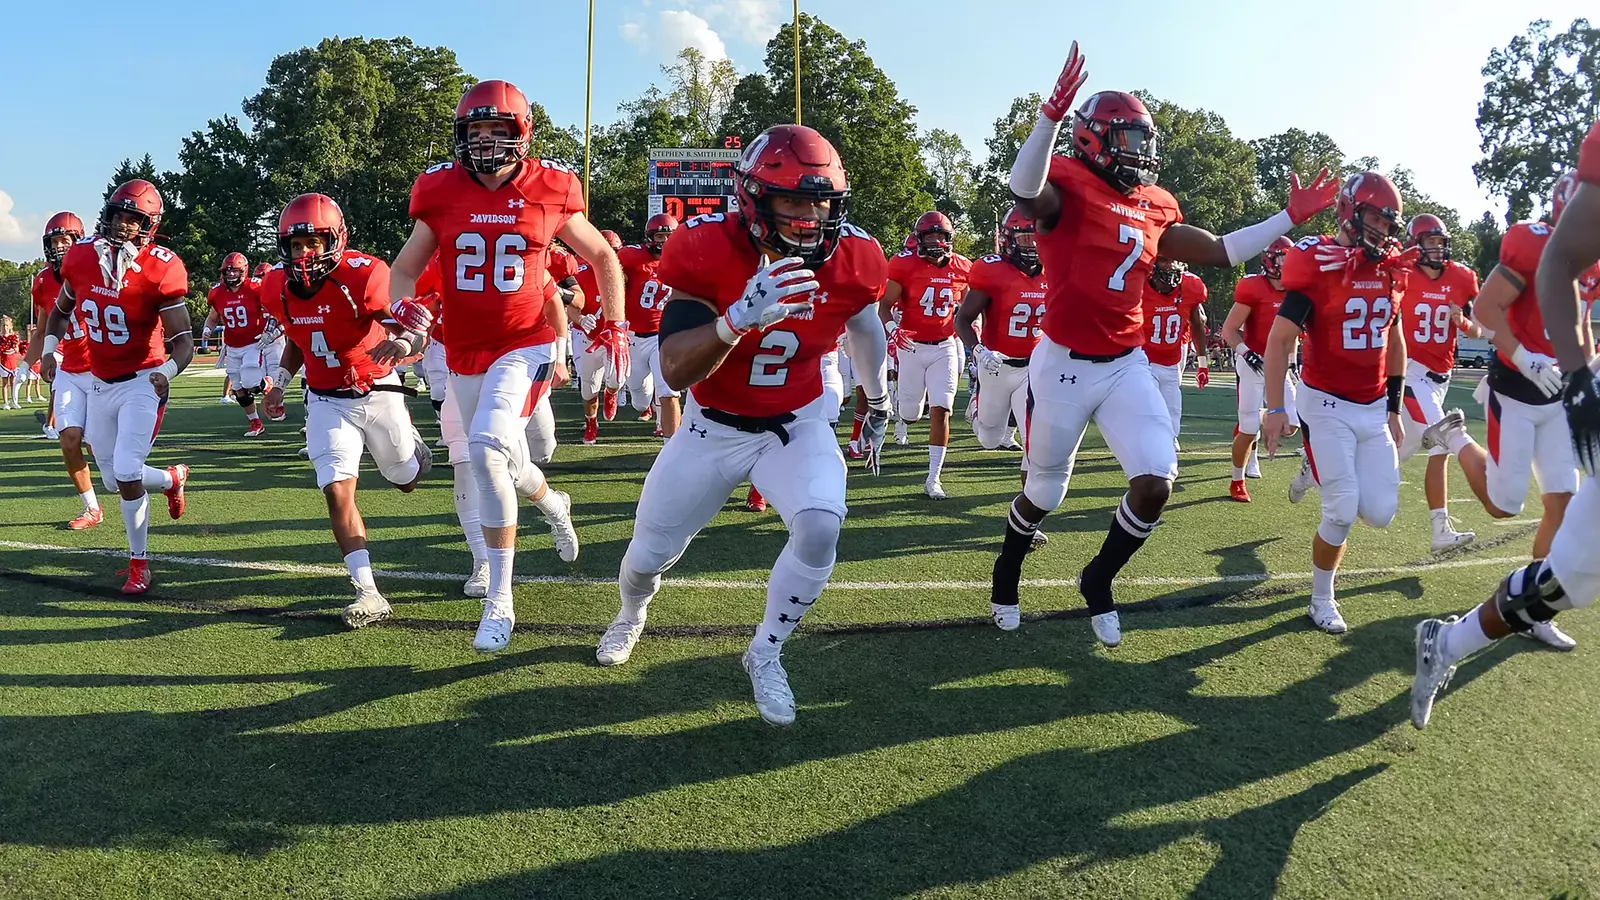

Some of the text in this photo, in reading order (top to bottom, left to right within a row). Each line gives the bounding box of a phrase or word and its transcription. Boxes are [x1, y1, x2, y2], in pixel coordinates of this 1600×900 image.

[724, 136, 741, 148] 25
[470, 213, 516, 224] DAVIDSON
[1110, 202, 1147, 222] DAVIDSON
[455, 232, 527, 292] 26
[1107, 223, 1144, 292] 7
[91, 284, 120, 299] DAVIDSON
[640, 280, 672, 311] 87
[919, 286, 954, 317] 43
[81, 298, 130, 345] 29
[223, 305, 248, 328] 59
[291, 316, 324, 324] DAVIDSON
[1150, 313, 1181, 345] 10
[1342, 297, 1392, 350] 22
[1413, 302, 1451, 344] 39
[310, 330, 341, 368] 4
[748, 329, 800, 387] 2
